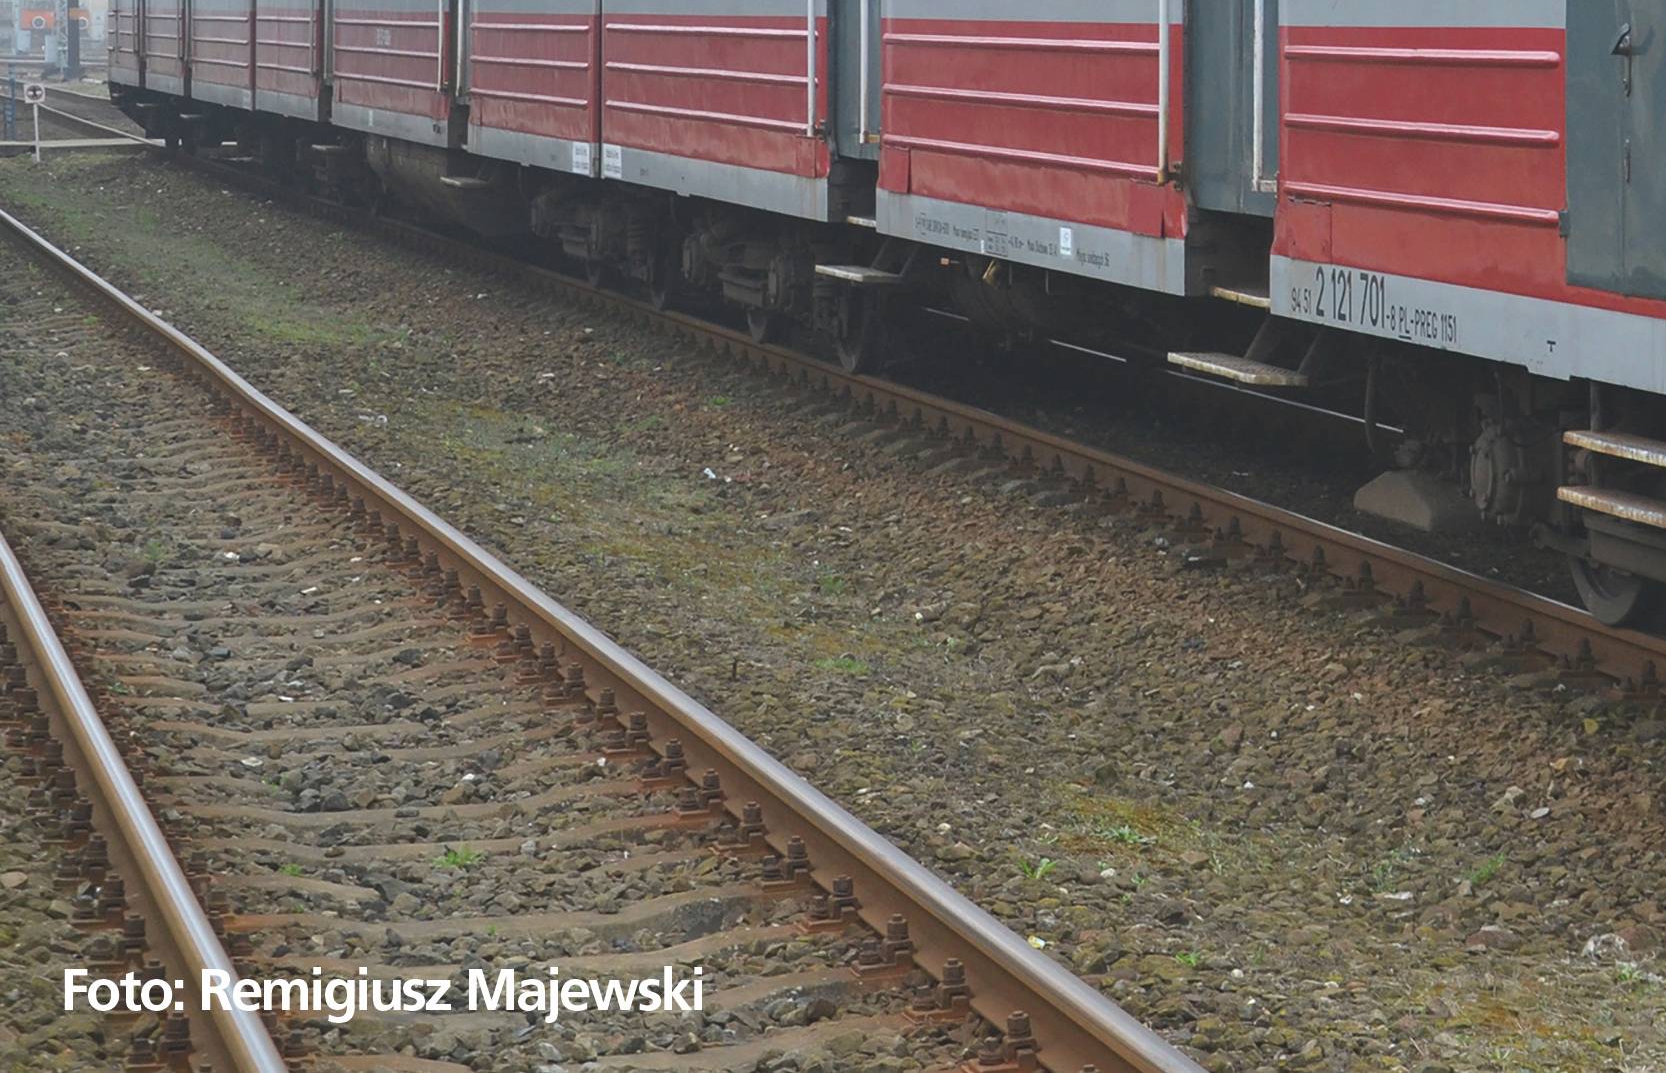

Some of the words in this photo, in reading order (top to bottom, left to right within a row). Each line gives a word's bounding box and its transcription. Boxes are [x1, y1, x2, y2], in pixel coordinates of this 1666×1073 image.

[1315, 266, 1325, 317] 2
[1331, 268, 1352, 323] 121
[1440, 313, 1457, 343] 1151
